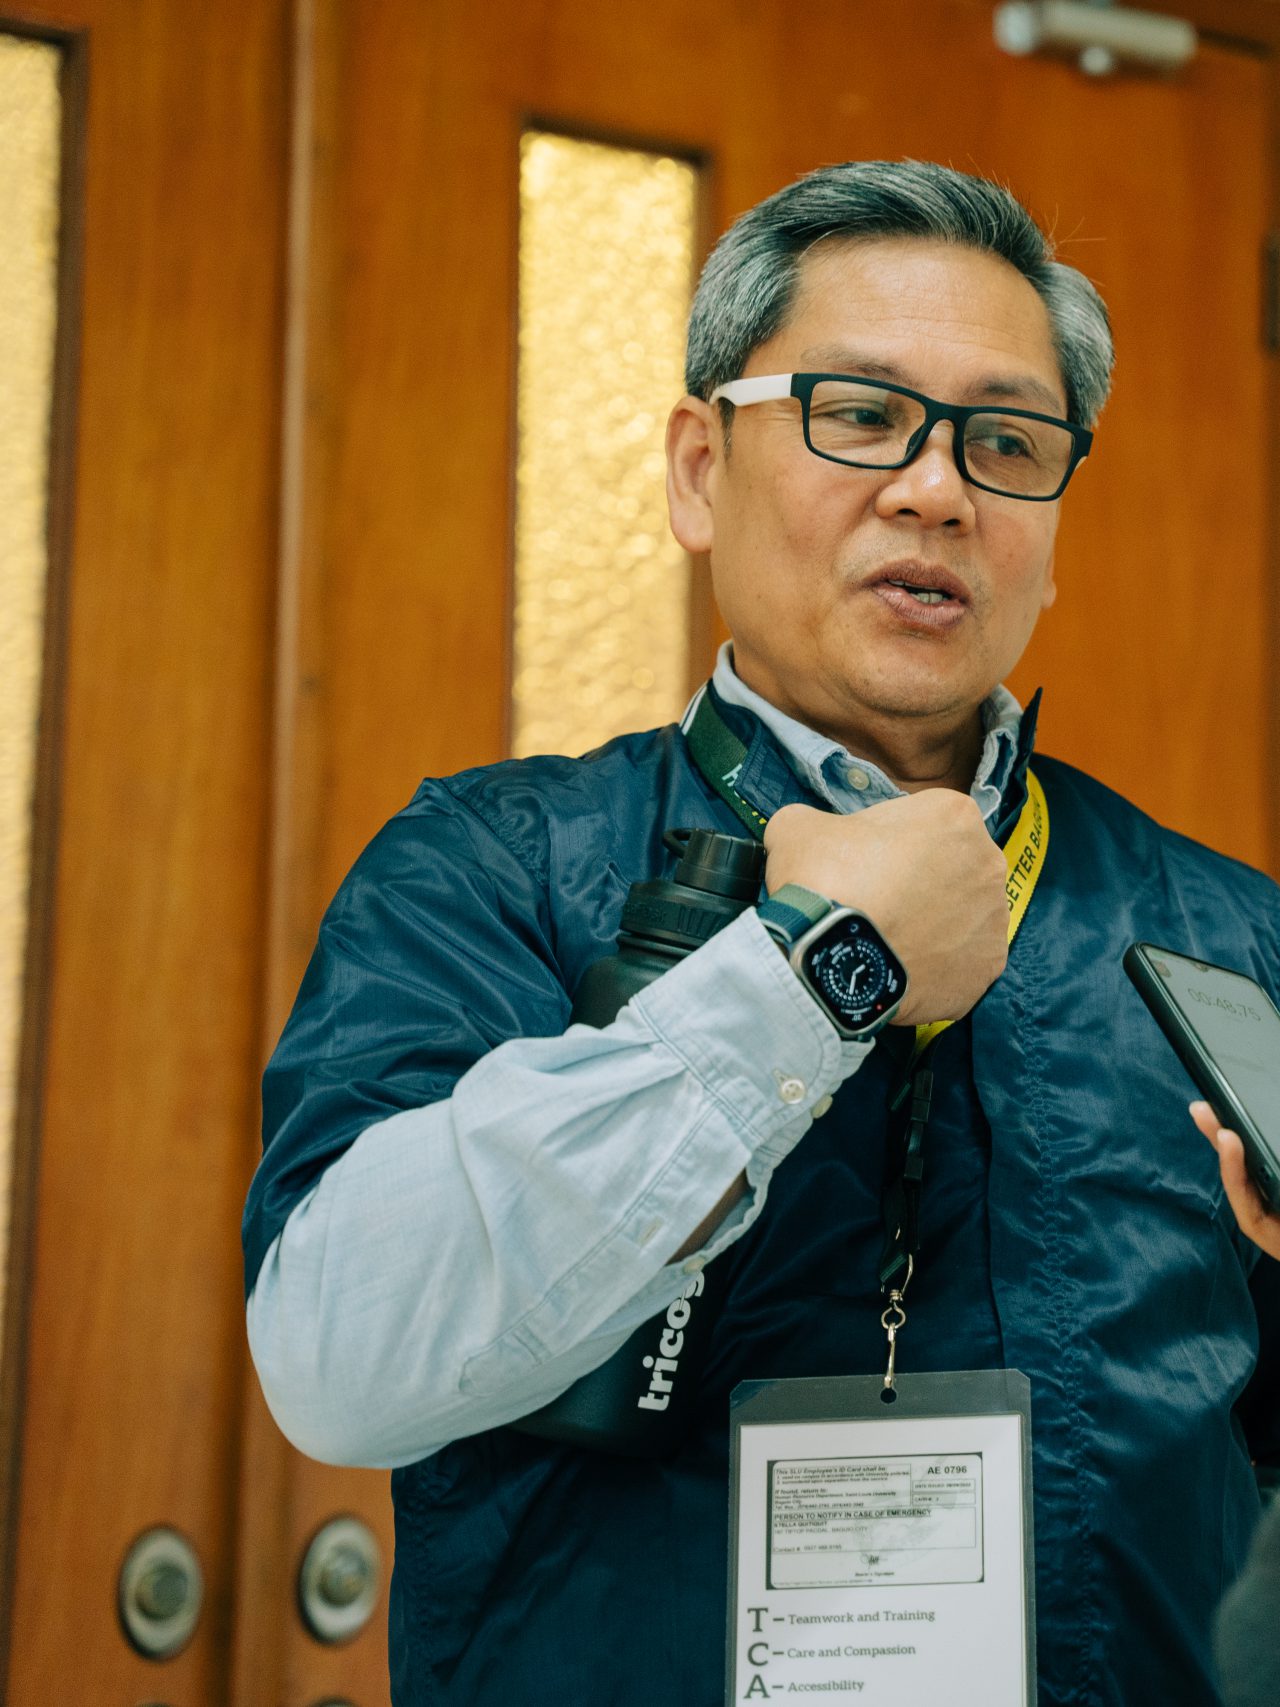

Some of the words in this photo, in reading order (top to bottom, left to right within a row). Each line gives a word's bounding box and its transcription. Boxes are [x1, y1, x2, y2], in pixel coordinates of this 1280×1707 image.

[927, 1466, 941, 1475] AE
[944, 1465, 967, 1474] 0796
[775, 1512, 803, 1520] PERSON
[818, 1511, 842, 1519] NOTIFY
[874, 1509, 884, 1517] OF
[886, 1508, 931, 1517] EMERGENCY
[747, 1607, 769, 1632] T
[787, 1612, 854, 1625] Teamwork
[857, 1611, 880, 1622] and
[883, 1609, 936, 1623] Training
[747, 1642, 769, 1667] C
[787, 1648, 815, 1659] Care
[818, 1646, 841, 1658] and
[844, 1644, 916, 1659] Compassion
[743, 1674, 771, 1699] A
[787, 1679, 865, 1693] Accessibility
